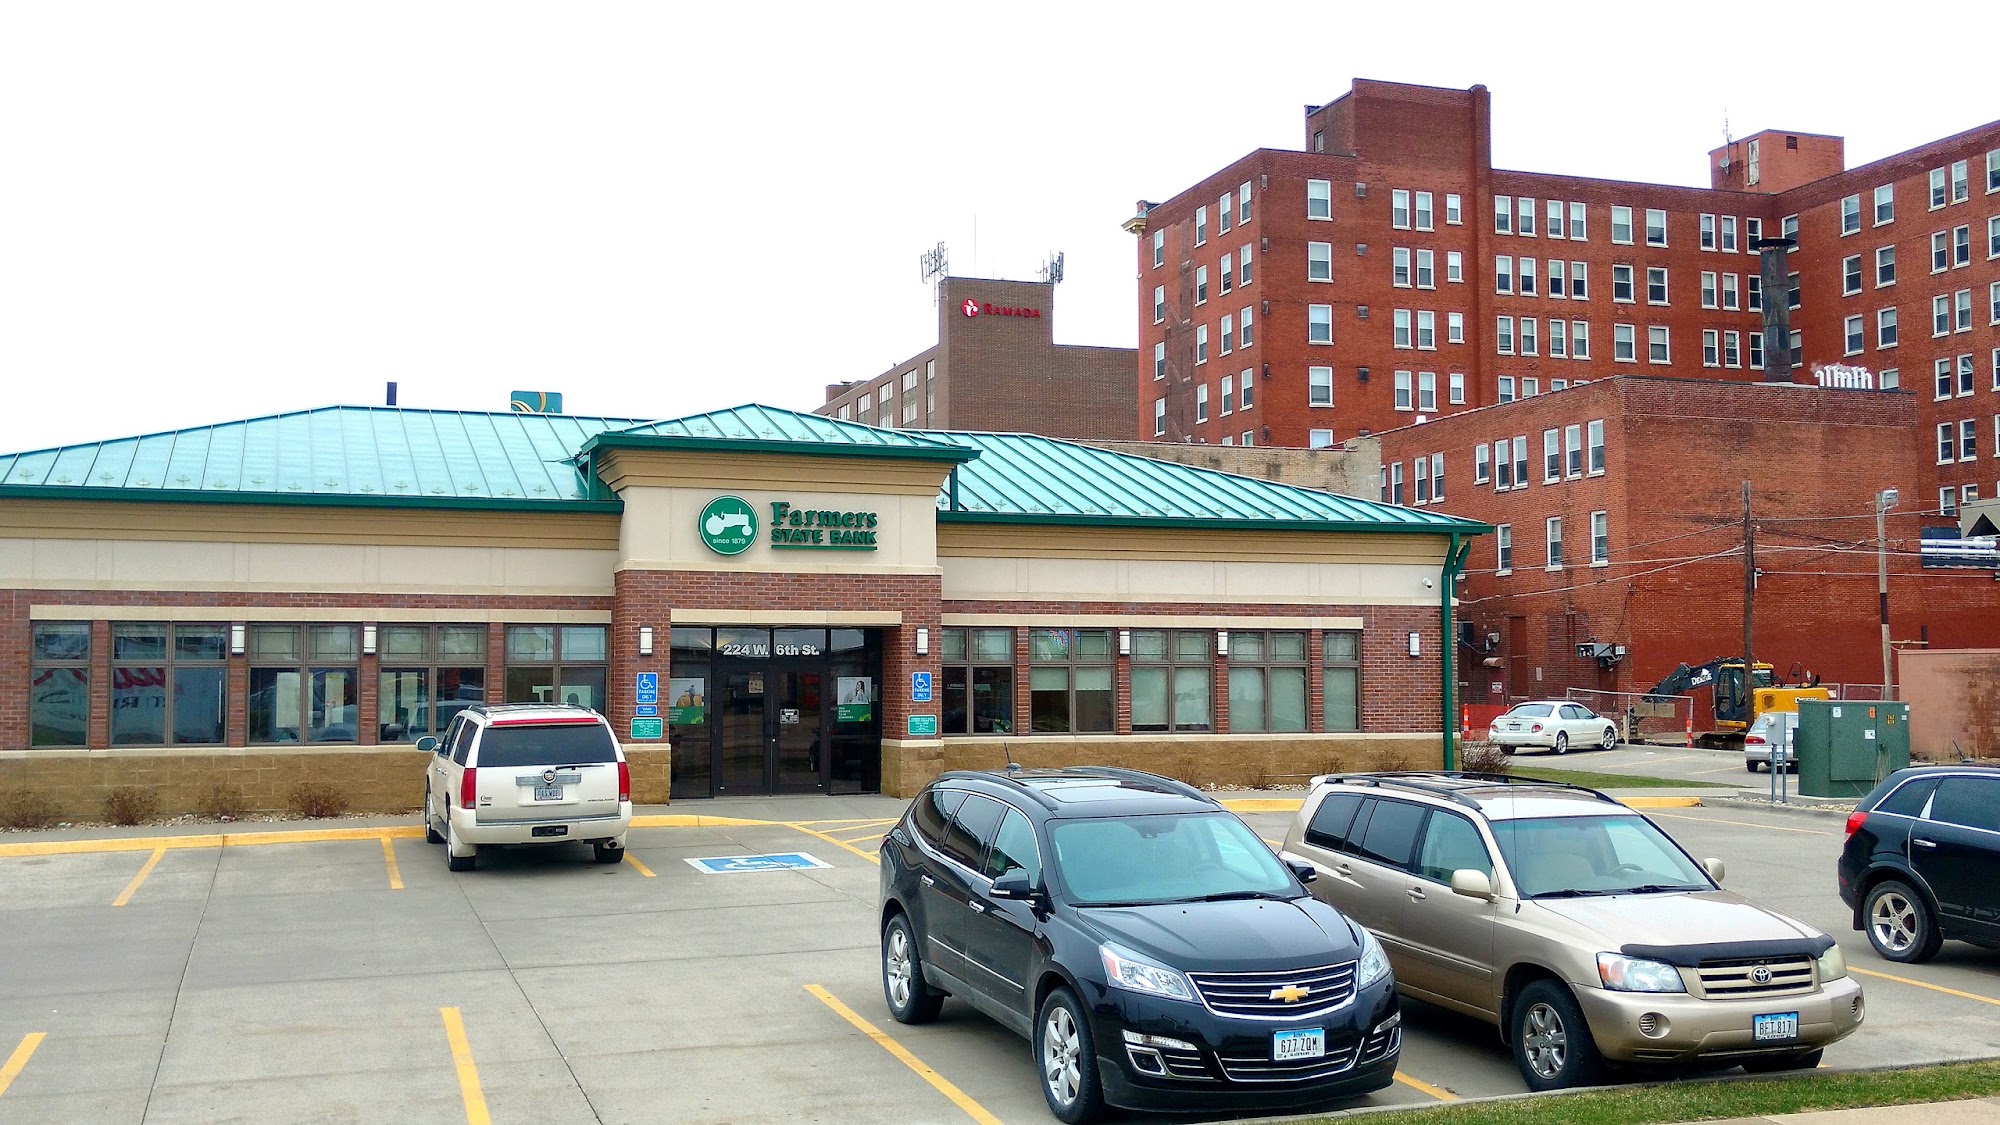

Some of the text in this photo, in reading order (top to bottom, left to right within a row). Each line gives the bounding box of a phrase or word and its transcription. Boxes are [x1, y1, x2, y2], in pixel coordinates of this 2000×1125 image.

[984, 303, 1040, 318] RAMADA
[770, 501, 877, 528] Farmers
[770, 528, 877, 545] STATE BANK
[723, 644, 820, 656] 224 W. 6th St.
[1777, 1020, 1791, 1034] 817
[1281, 1037, 1317, 1053] 677 ZQM
